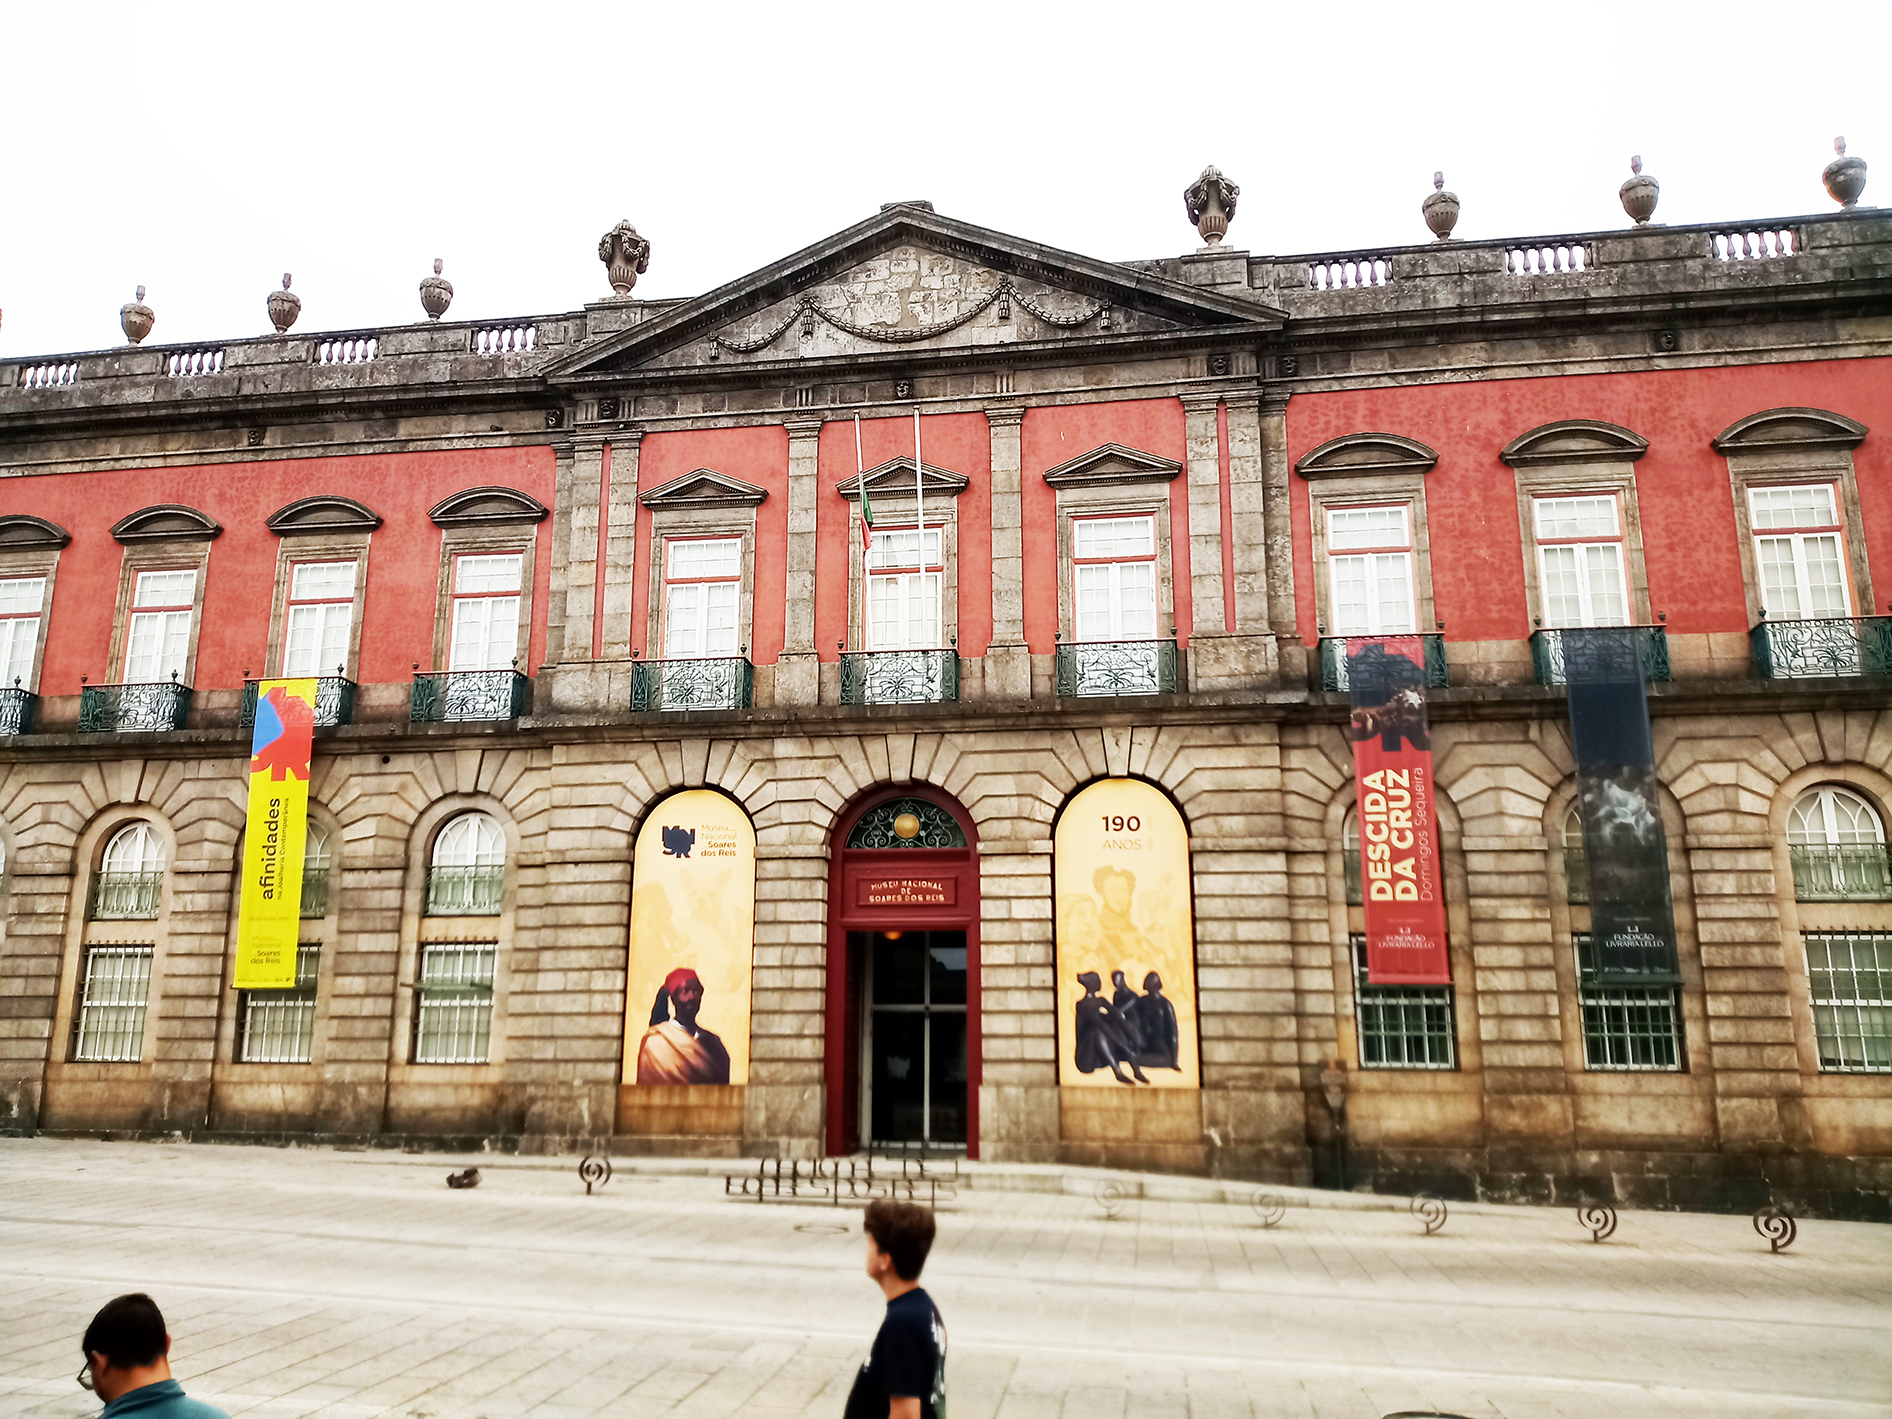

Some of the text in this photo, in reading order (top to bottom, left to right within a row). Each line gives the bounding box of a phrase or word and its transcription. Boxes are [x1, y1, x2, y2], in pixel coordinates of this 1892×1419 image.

[1386, 769, 1414, 849] CRUZ
[701, 824, 729, 832] Museu
[1101, 815, 1141, 832] 190
[701, 832, 737, 840] Nacional
[1363, 770, 1393, 901] DESCIDA
[1412, 767, 1433, 901] Domingos Sequeira
[259, 798, 281, 900] afinidades
[707, 840, 737, 849] Soares
[1101, 839, 1142, 850] ANOS
[700, 849, 737, 857] dos Reis
[1393, 857, 1418, 901] DA
[871, 880, 943, 890] MUSEU NACIONAL
[905, 894, 923, 902] DOS
[926, 894, 945, 902] REIS
[257, 949, 281, 957] Soares
[250, 957, 281, 965] dos Reis
